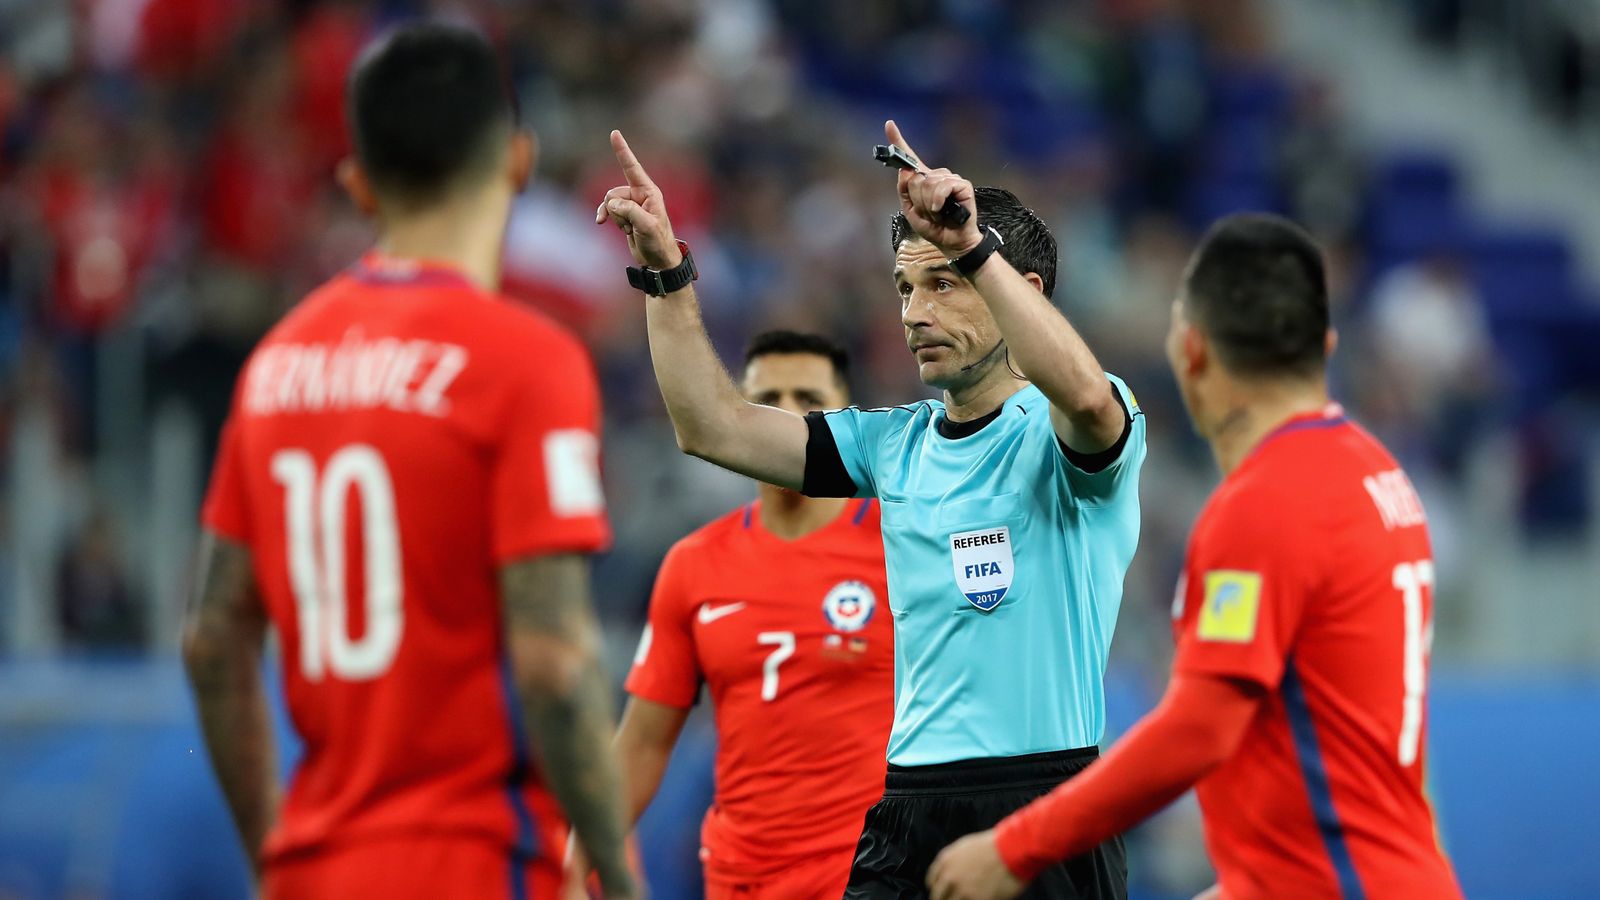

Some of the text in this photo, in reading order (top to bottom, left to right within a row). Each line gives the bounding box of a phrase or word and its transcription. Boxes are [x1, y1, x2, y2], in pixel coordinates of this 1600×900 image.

[953, 532, 1006, 550] REFEREE
[271, 444, 403, 682] 10
[964, 561, 1002, 579] FIFA
[976, 593, 998, 604] 2017
[757, 631, 796, 701] 7
